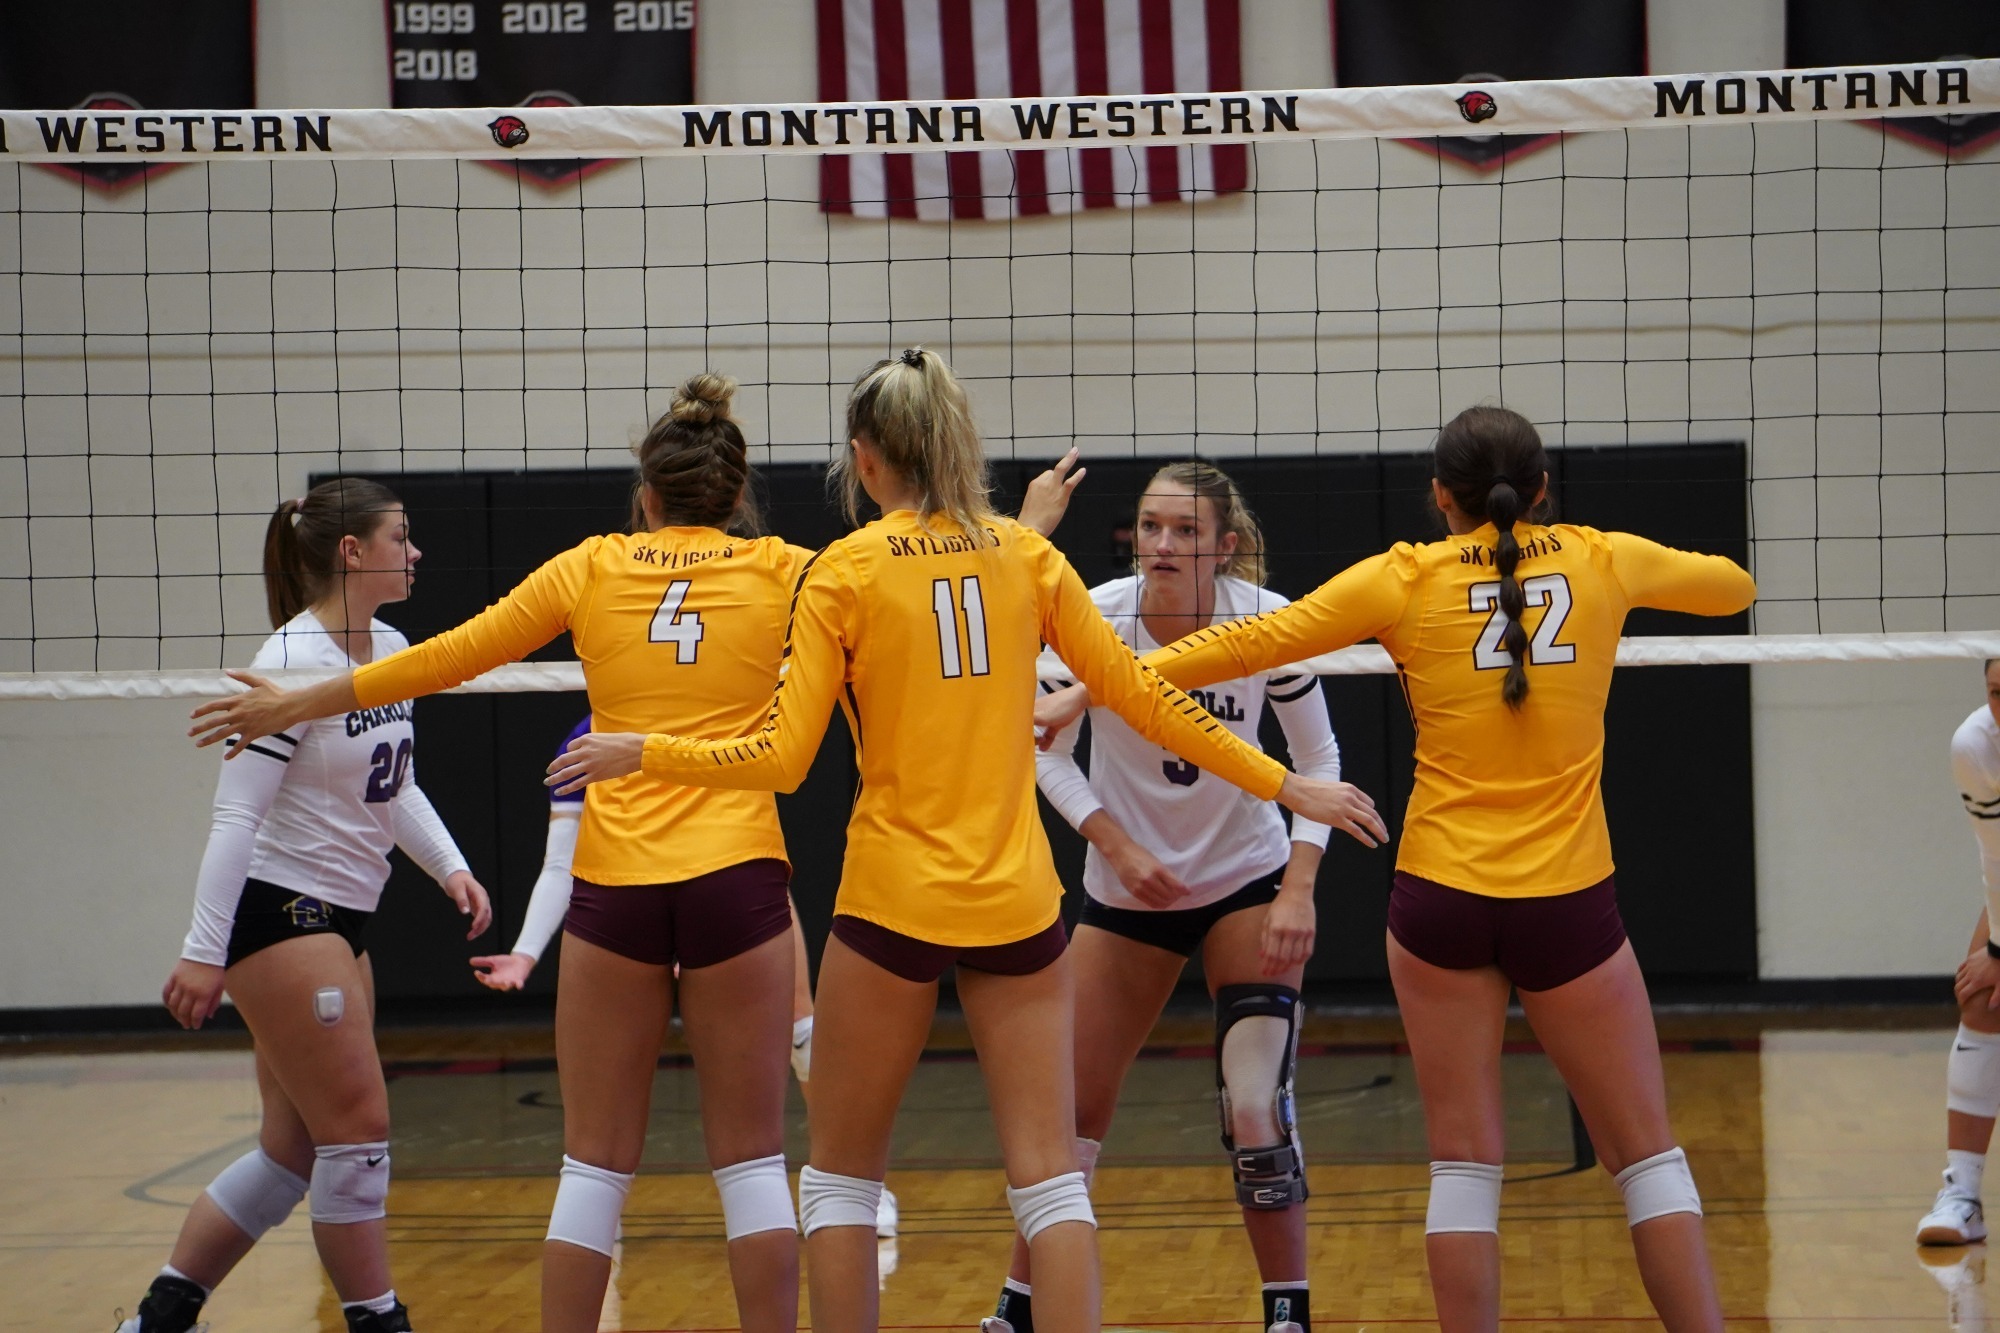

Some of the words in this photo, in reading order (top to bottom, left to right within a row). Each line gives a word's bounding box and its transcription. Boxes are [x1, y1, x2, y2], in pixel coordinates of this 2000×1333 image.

[394, 4, 474, 34] 1999
[502, 3, 587, 33] 2012
[614, 1, 694, 32] 2015
[394, 50, 477, 80] 2018
[1653, 68, 1970, 117] MONTANA
[36, 115, 332, 153] WESTERN
[683, 106, 984, 147] MONTANA
[1011, 96, 1299, 140] WESTERN
[886, 528, 1001, 556] SKYLIGHS
[648, 580, 703, 665] 4
[932, 575, 990, 679] 11
[1468, 573, 1576, 671] 22
[363, 738, 412, 803] 20
